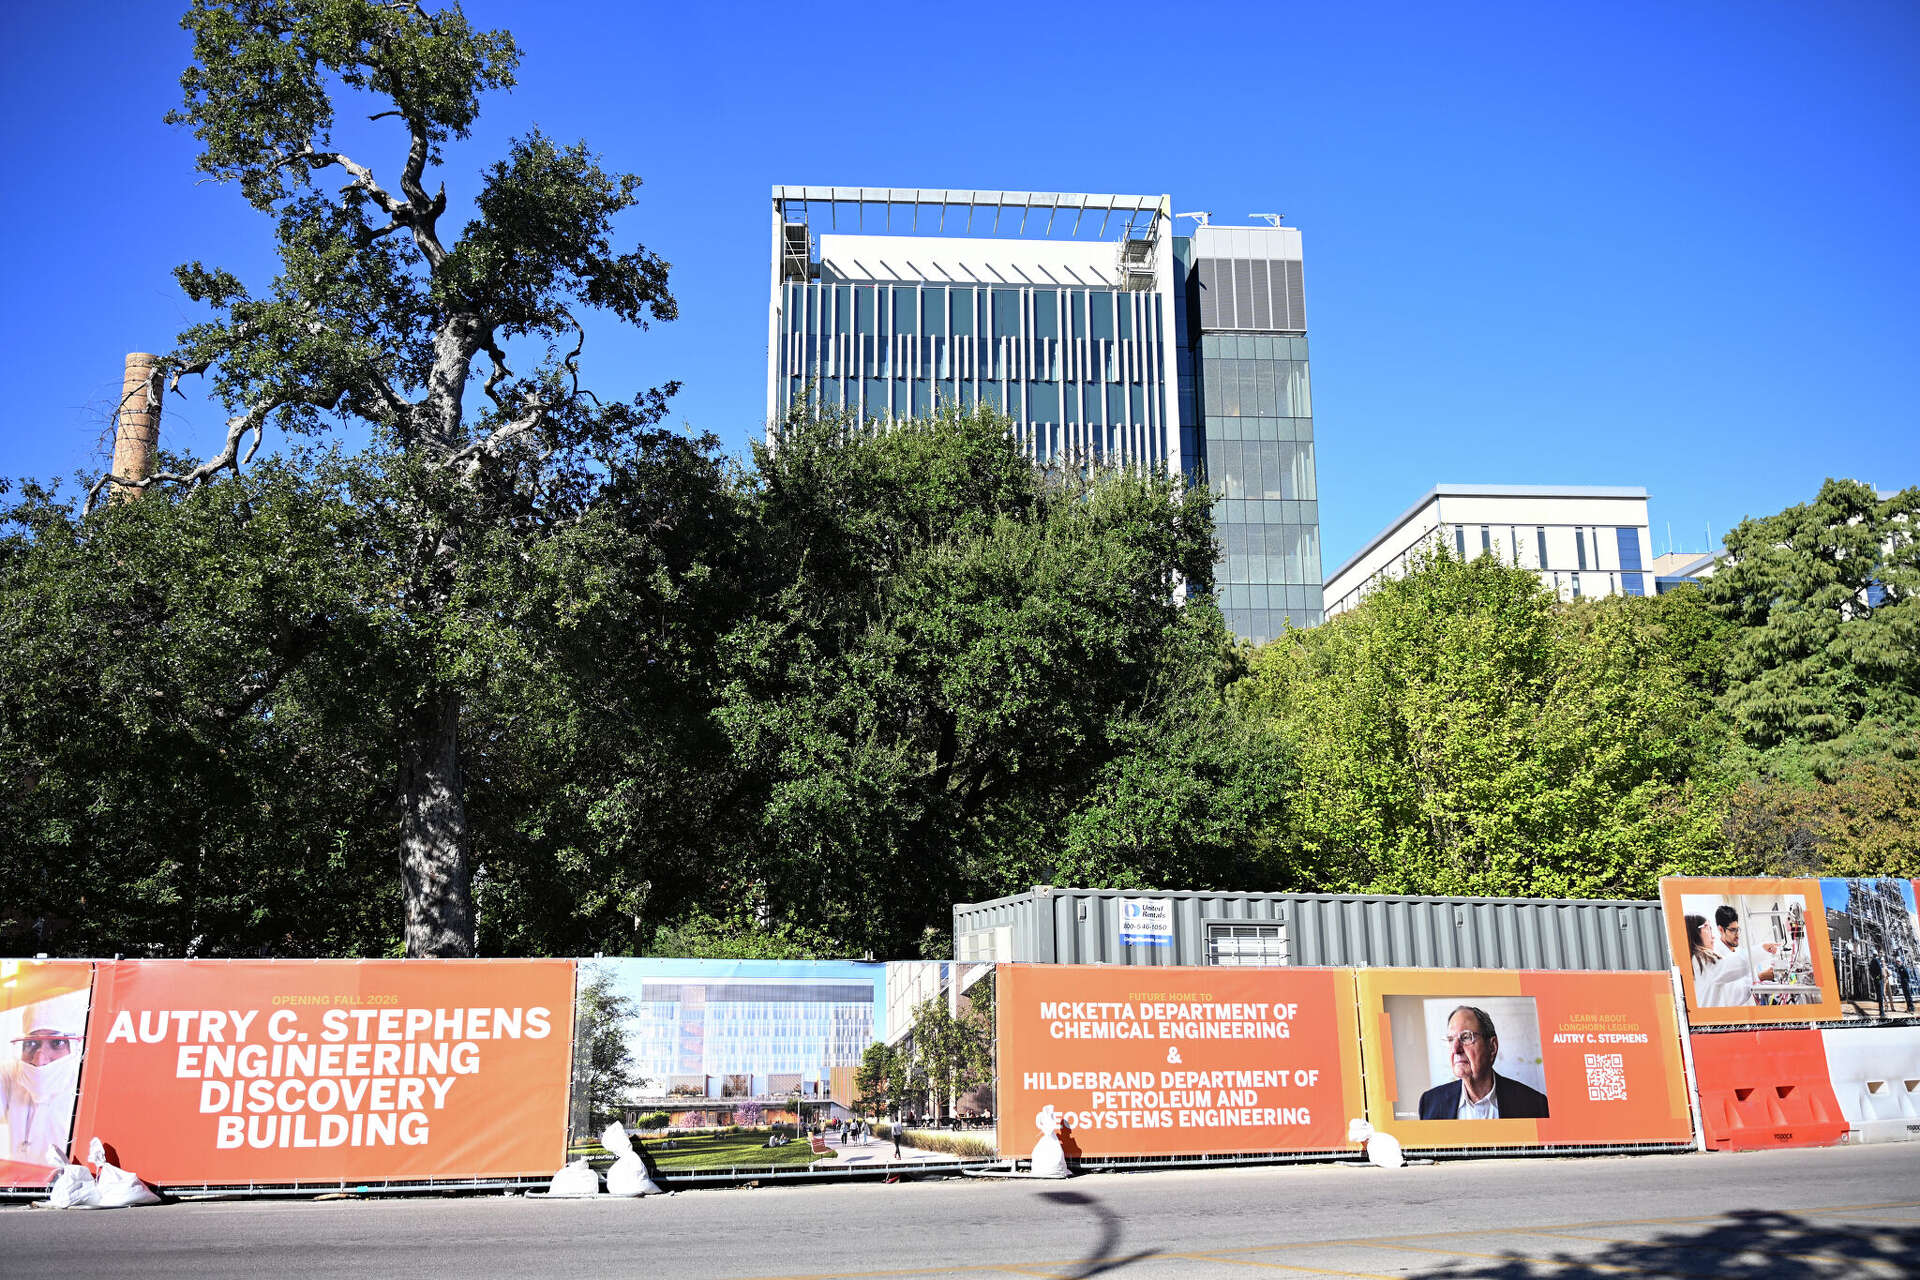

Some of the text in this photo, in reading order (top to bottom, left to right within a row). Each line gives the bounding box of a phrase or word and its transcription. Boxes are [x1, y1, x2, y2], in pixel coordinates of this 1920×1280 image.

[1142, 911, 1166, 919] Rentals
[271, 994, 399, 1005] OPENING FALL 2026
[1128, 992, 1213, 1001] FUTURE HOME TO
[1040, 1002, 1298, 1020] MCKETTA DEPARTMENT OF
[1569, 1014, 1627, 1023] LEARN ABOUT
[106, 1006, 552, 1044] AUTRY C. STEPHENS
[1049, 1021, 1290, 1039] CHEMICAL ENGINEERING
[1559, 1023, 1640, 1032] LONGHORN LEGEND
[1553, 1033, 1649, 1044] AUTRY C. STEPHENS
[175, 1042, 481, 1079] ENGINEERING
[1166, 1046, 1183, 1064] &
[1023, 1069, 1319, 1091] HILDEBRAND DEPARTMENT OF
[199, 1077, 457, 1114] DISCOVERY
[1091, 1089, 1258, 1109] PETROLEUM AND
[1045, 1107, 1311, 1130] EOSYSTEMS ENGINEERING
[216, 1111, 430, 1150] BUILDING
